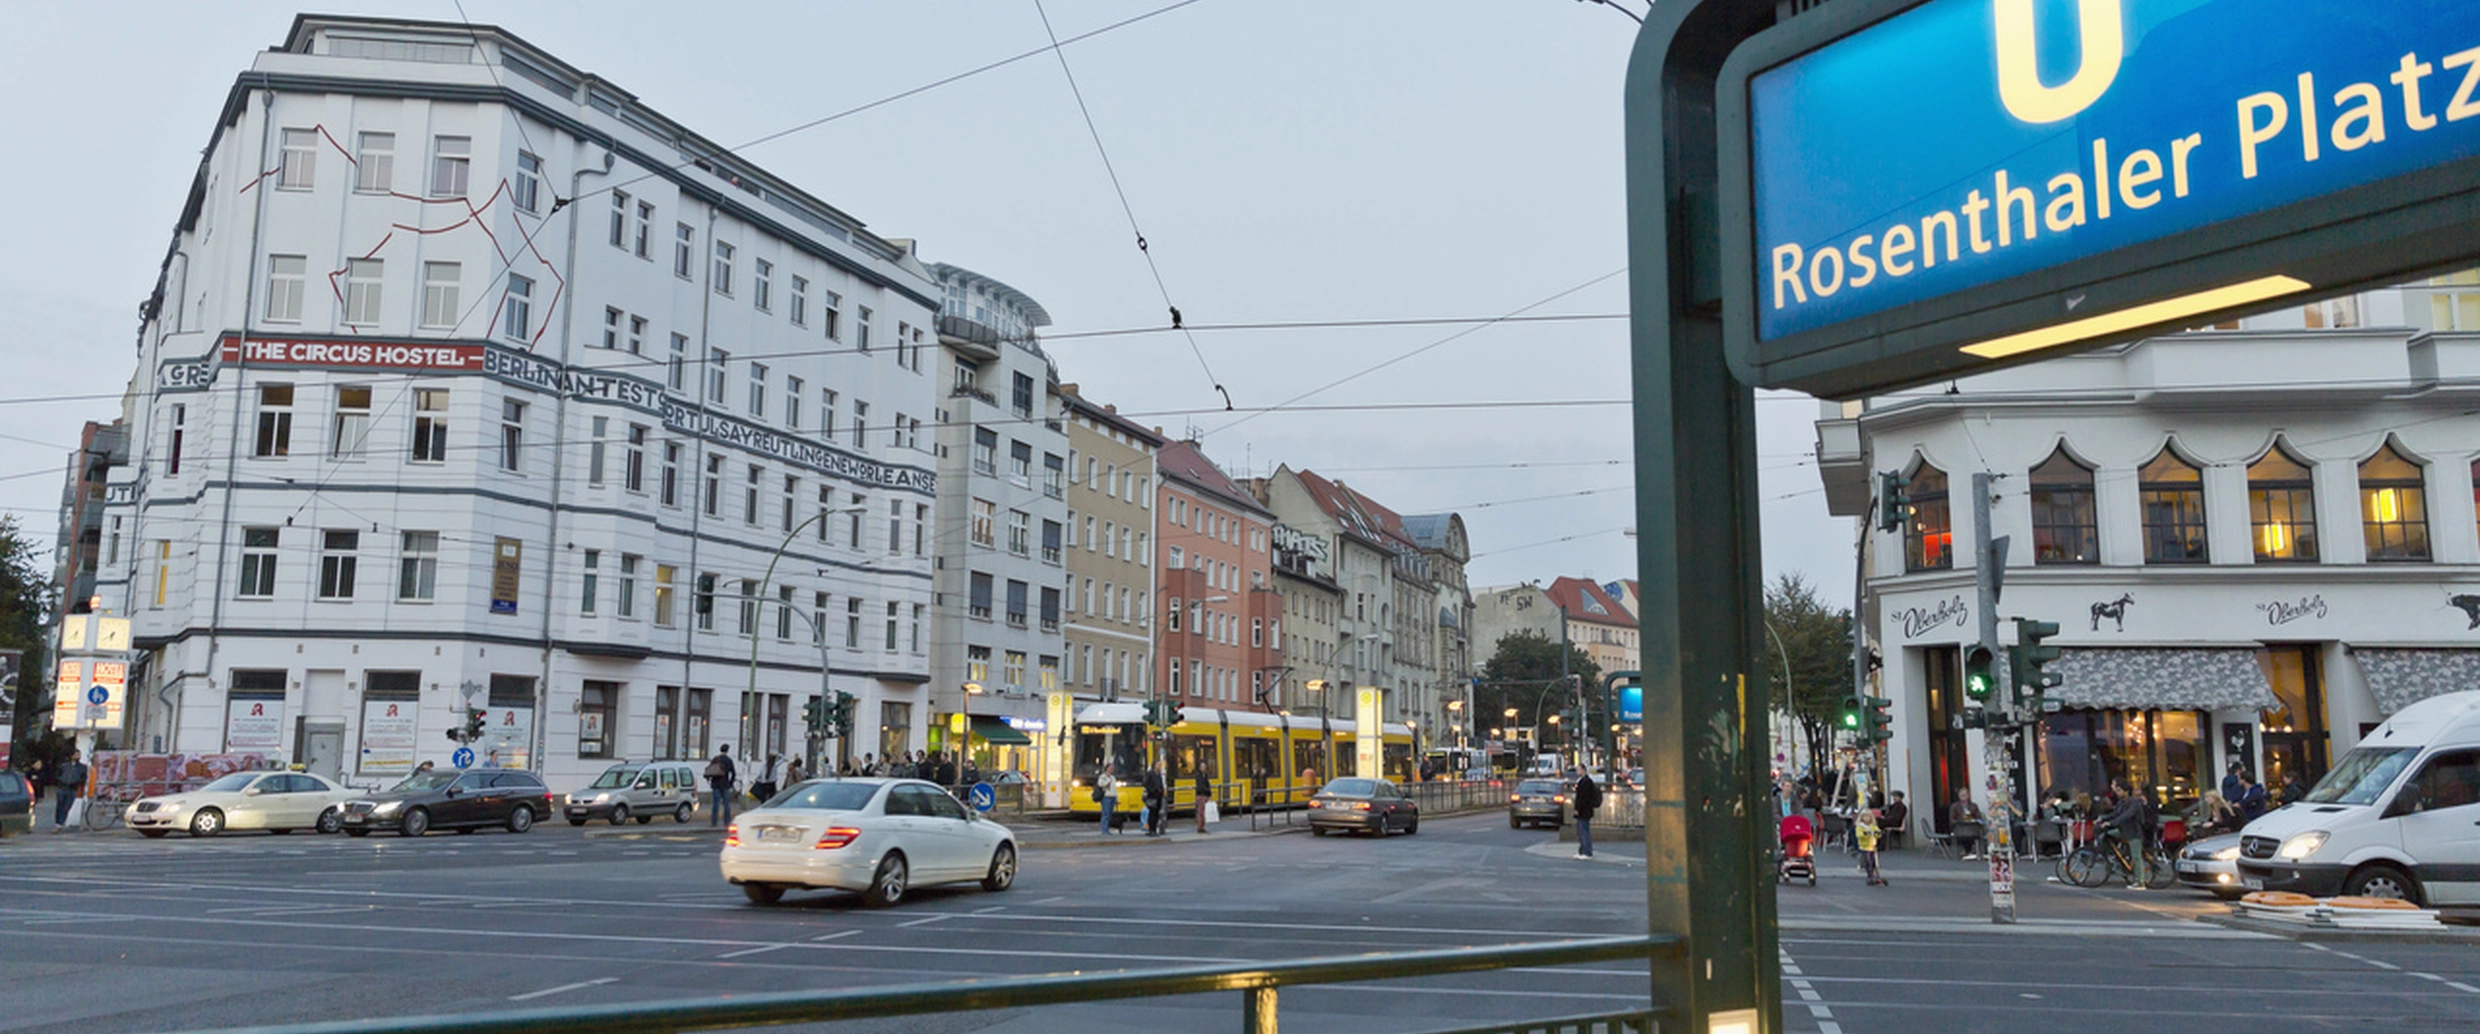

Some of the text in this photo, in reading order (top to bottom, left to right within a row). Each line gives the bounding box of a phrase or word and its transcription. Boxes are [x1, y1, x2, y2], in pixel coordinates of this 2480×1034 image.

[1993, 0, 2123, 123] U
[1772, 46, 2480, 310] Rosenthaler Platz
[244, 341, 465, 366] THE CIRCUS HOSTEL
[1902, 594, 1968, 638] Oberholz
[2266, 594, 2328, 626] Oberholz
